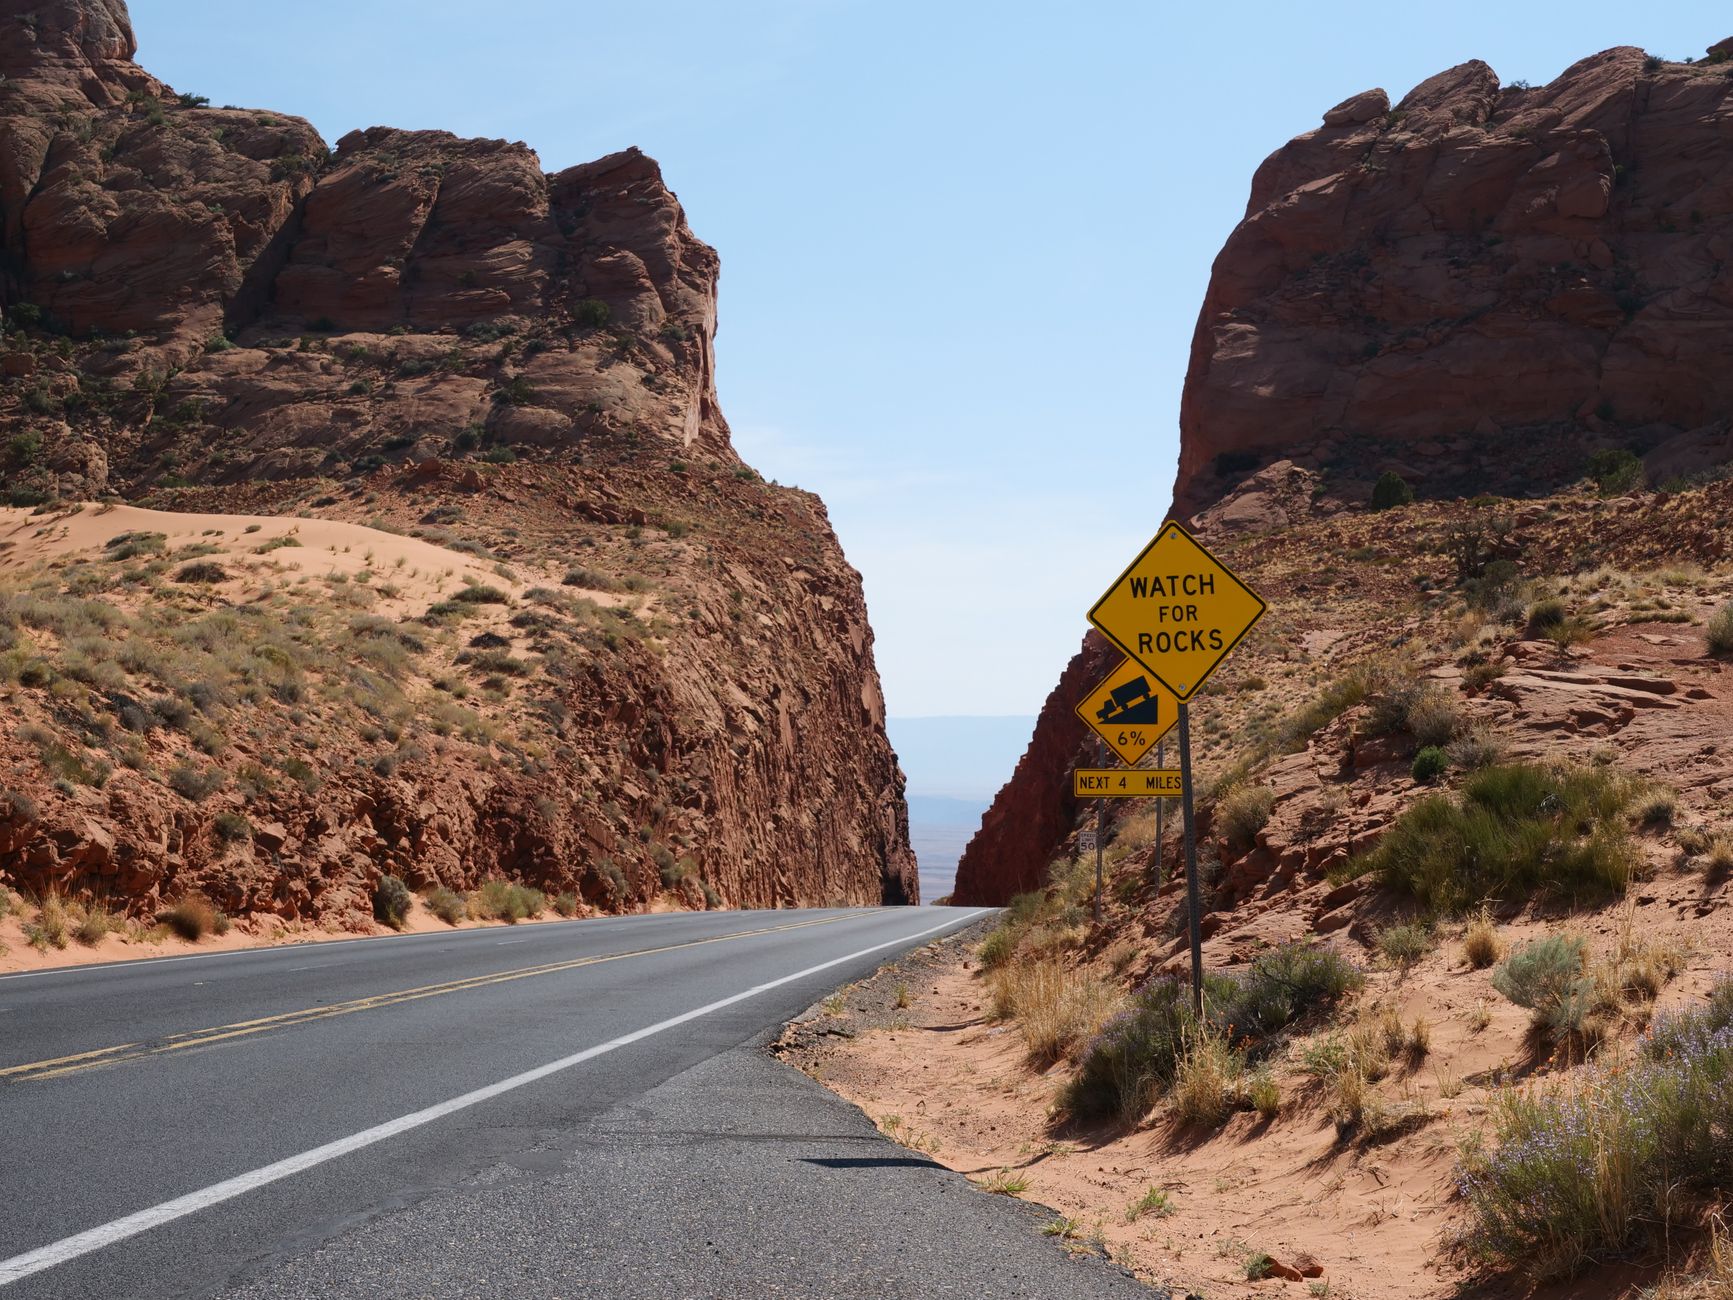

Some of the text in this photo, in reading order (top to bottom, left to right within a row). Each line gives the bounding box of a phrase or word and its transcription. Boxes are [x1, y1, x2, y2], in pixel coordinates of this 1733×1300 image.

[1130, 573, 1215, 598] WATCH
[1159, 605, 1198, 623] FOR
[1138, 629, 1223, 654] ROCKS
[1118, 731, 1145, 746] 6%
[1080, 776, 1181, 789] NEXT 4 MILES
[1080, 842, 1095, 851] 50
